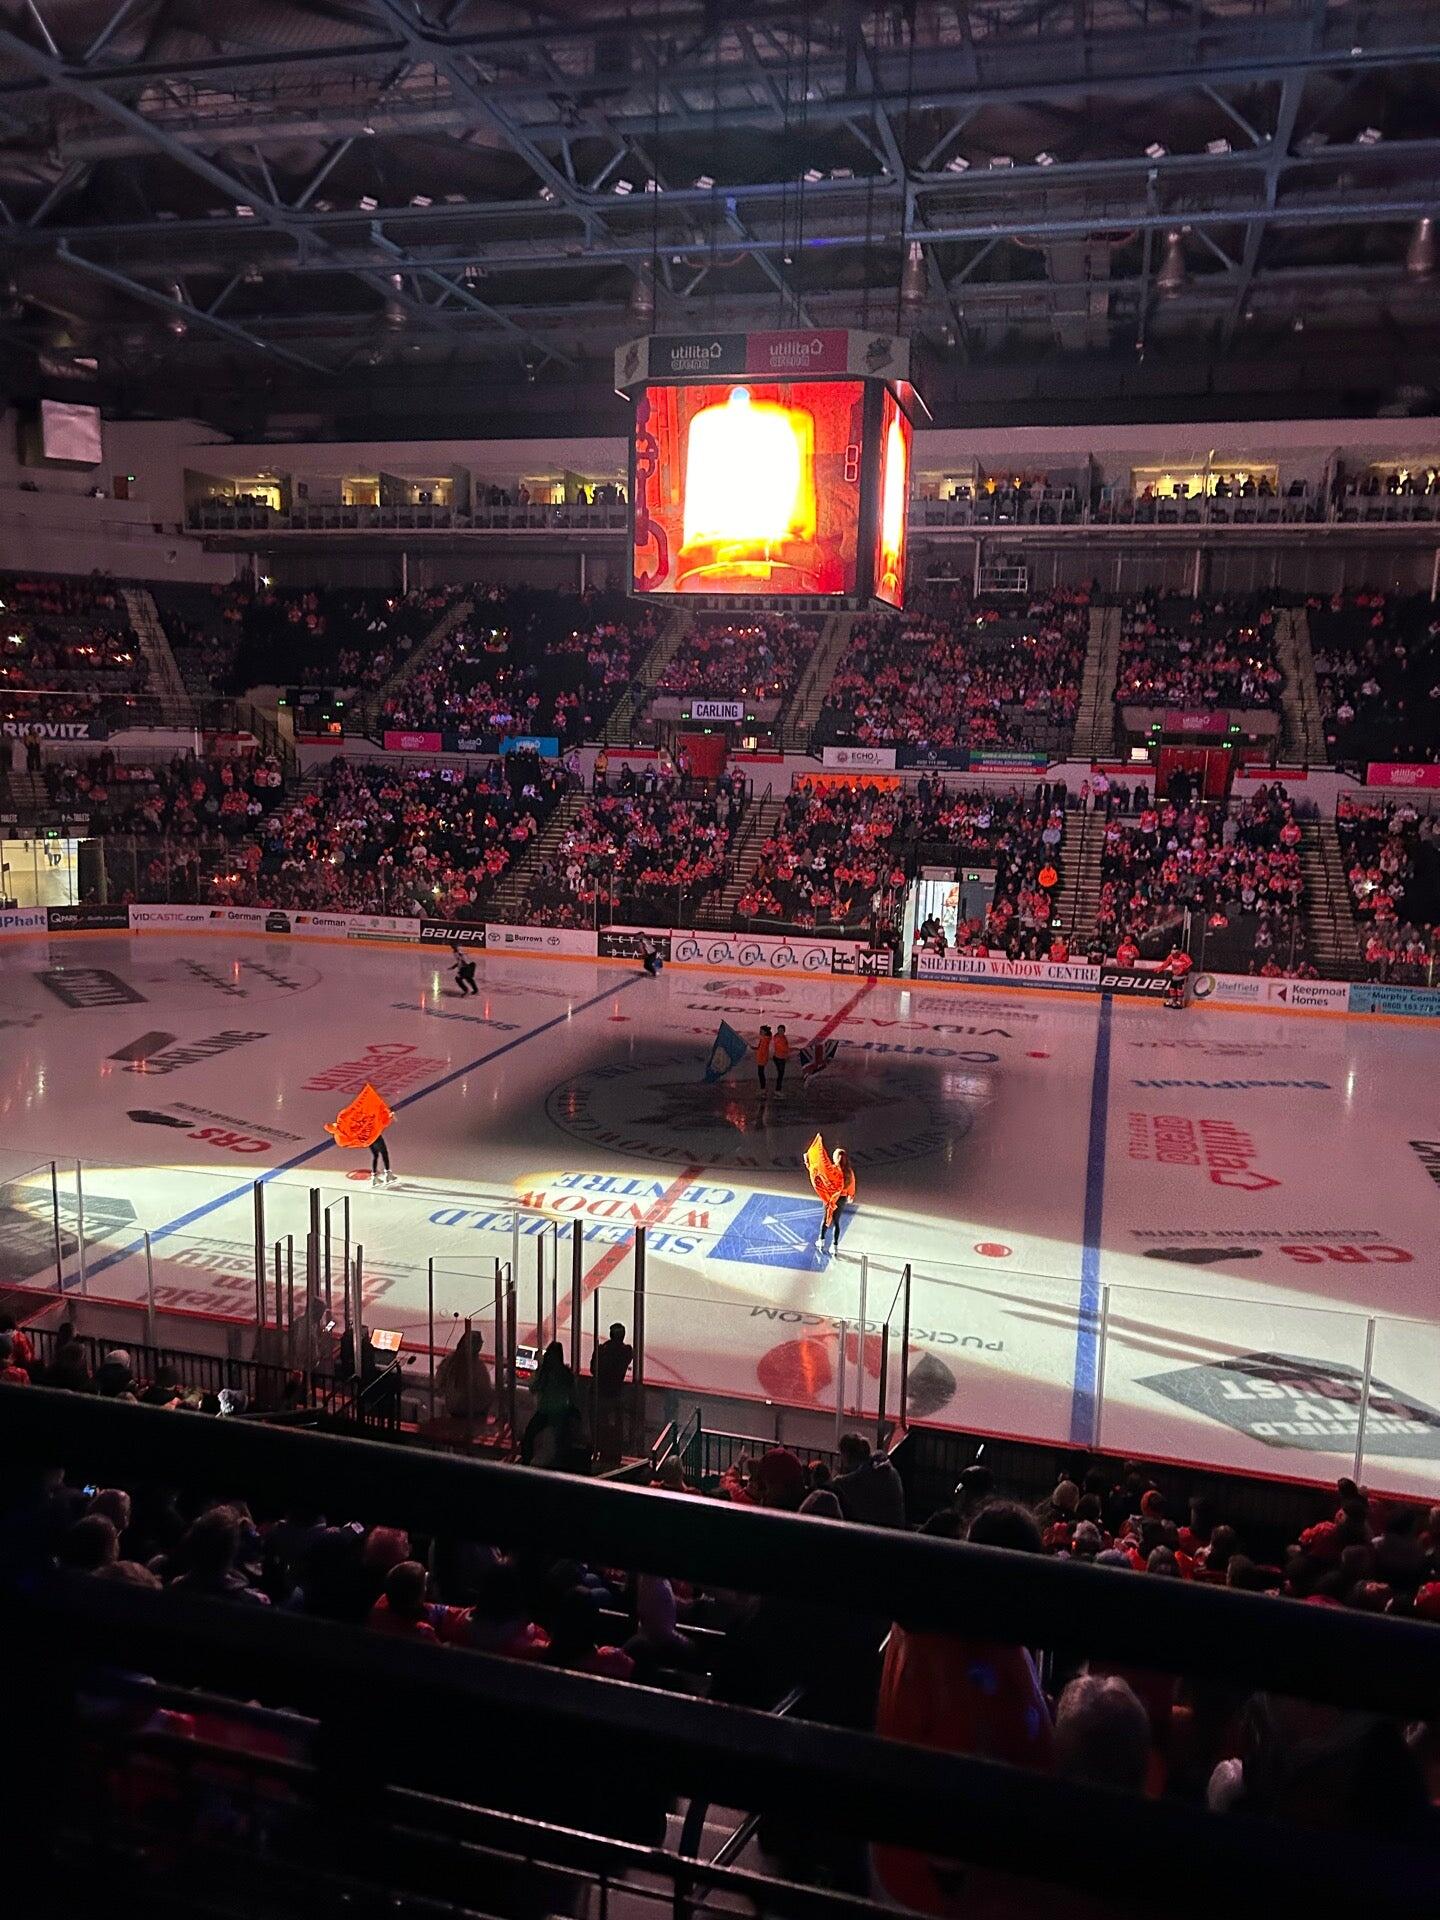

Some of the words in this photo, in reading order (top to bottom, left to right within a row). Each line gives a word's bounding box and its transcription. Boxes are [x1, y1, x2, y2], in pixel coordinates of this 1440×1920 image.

[671, 344, 709, 358] utilita
[770, 341, 809, 356] utilita
[696, 704, 738, 718] CARLING
[0, 722, 89, 738] RKOVITZ
[851, 752, 874, 760] ECHO
[132, 912, 205, 921] VIDCASTIC.com
[227, 911, 262, 921] German
[312, 917, 346, 927] German
[421, 927, 486, 942] BAUER
[514, 933, 543, 943] Burrows
[607, 935, 667, 947] KETLE
[920, 957, 986, 974] SHEFFIELD
[990, 961, 1044, 978] WINDOW
[1048, 966, 1098, 981] CENTRE
[1217, 981, 1259, 992] Sheffield
[1292, 984, 1346, 998] Keepmoat
[1292, 996, 1329, 1006] Homes
[1372, 992, 1407, 1001] Murphy
[686, 1003, 1012, 1039] VIDCASTIC.com
[187, 1127, 272, 1153] CRS
[1200, 1119, 1258, 1170] utilita
[553, 1171, 735, 1206] CENTRE
[519, 1189, 710, 1229] WINDOW
[429, 1207, 703, 1255] SHEFFIELD
[1279, 1245, 1415, 1264] CRS
[1249, 1420, 1431, 1436] SHEFFIELD
